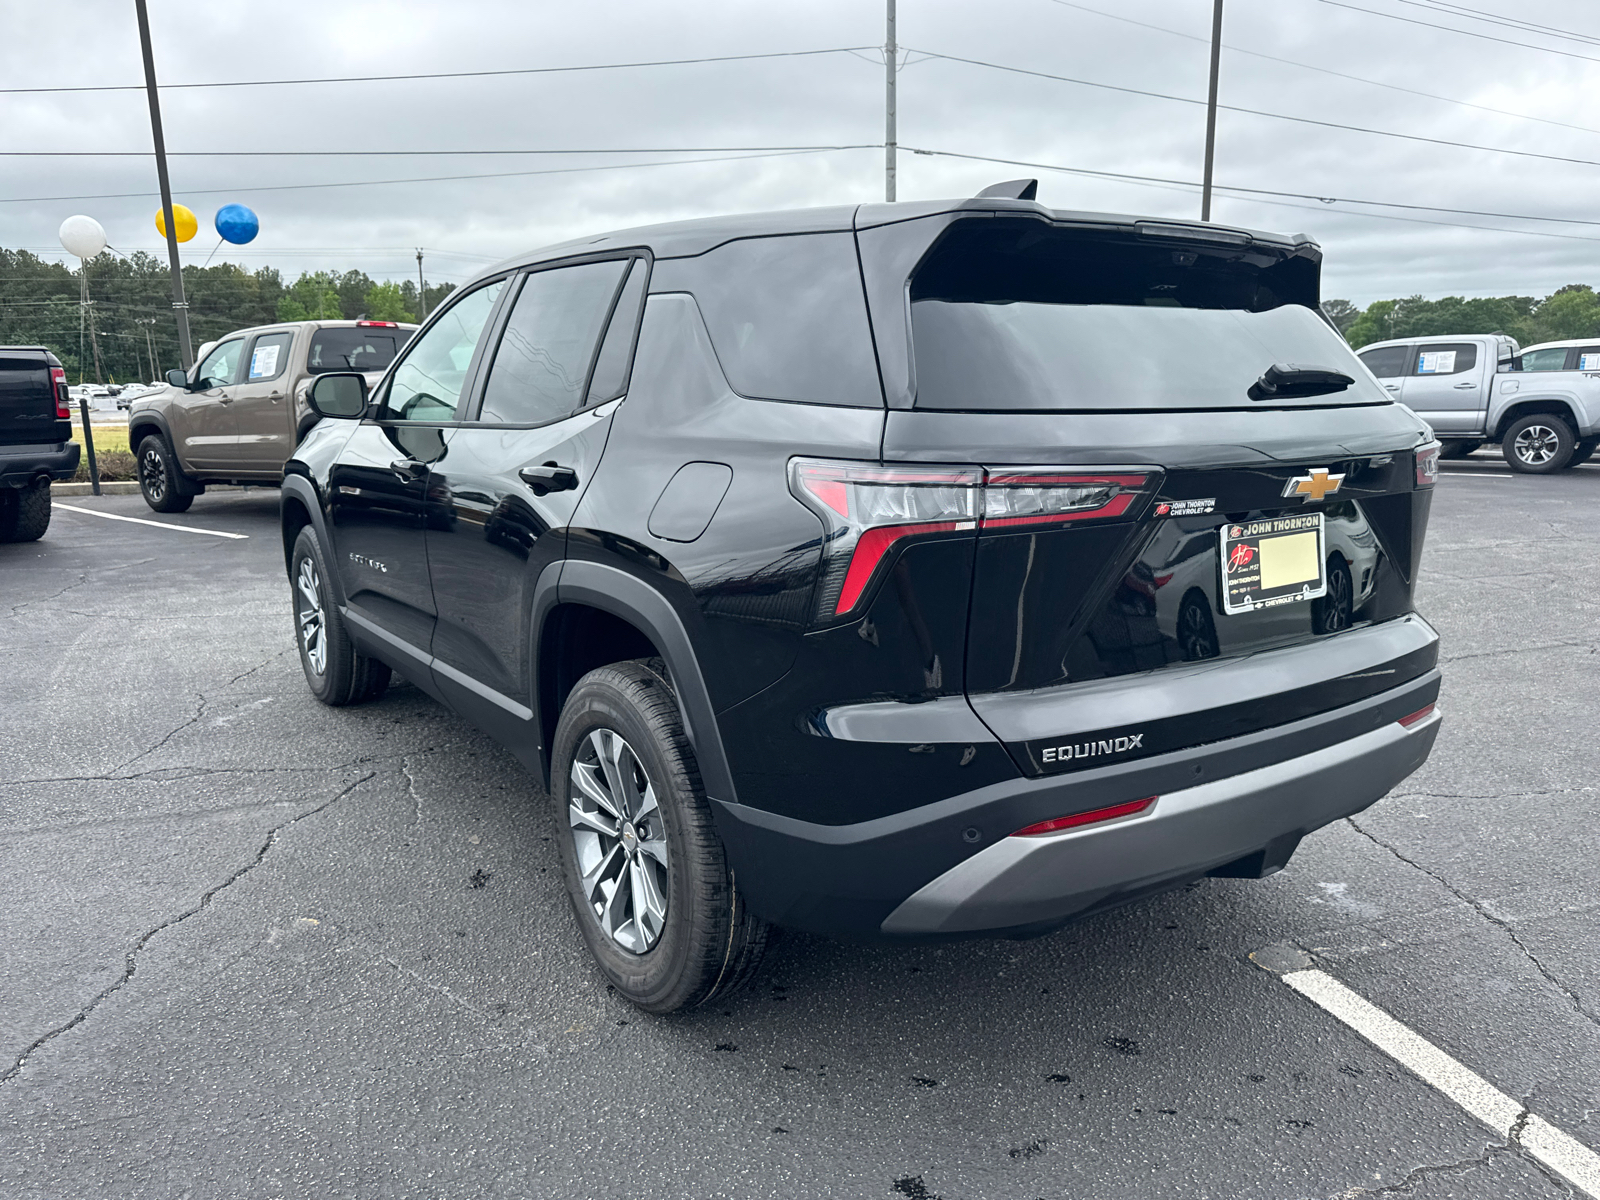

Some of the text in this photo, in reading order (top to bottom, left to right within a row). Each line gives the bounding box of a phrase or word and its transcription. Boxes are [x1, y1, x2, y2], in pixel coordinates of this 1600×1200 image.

[1170, 507, 1204, 516] CHEVROLET
[1171, 502, 1186, 510] JOHN
[1246, 515, 1319, 535] JOHN THORNTON
[1265, 596, 1294, 607] CHEVROLET
[1042, 733, 1144, 763] EQUINOX
